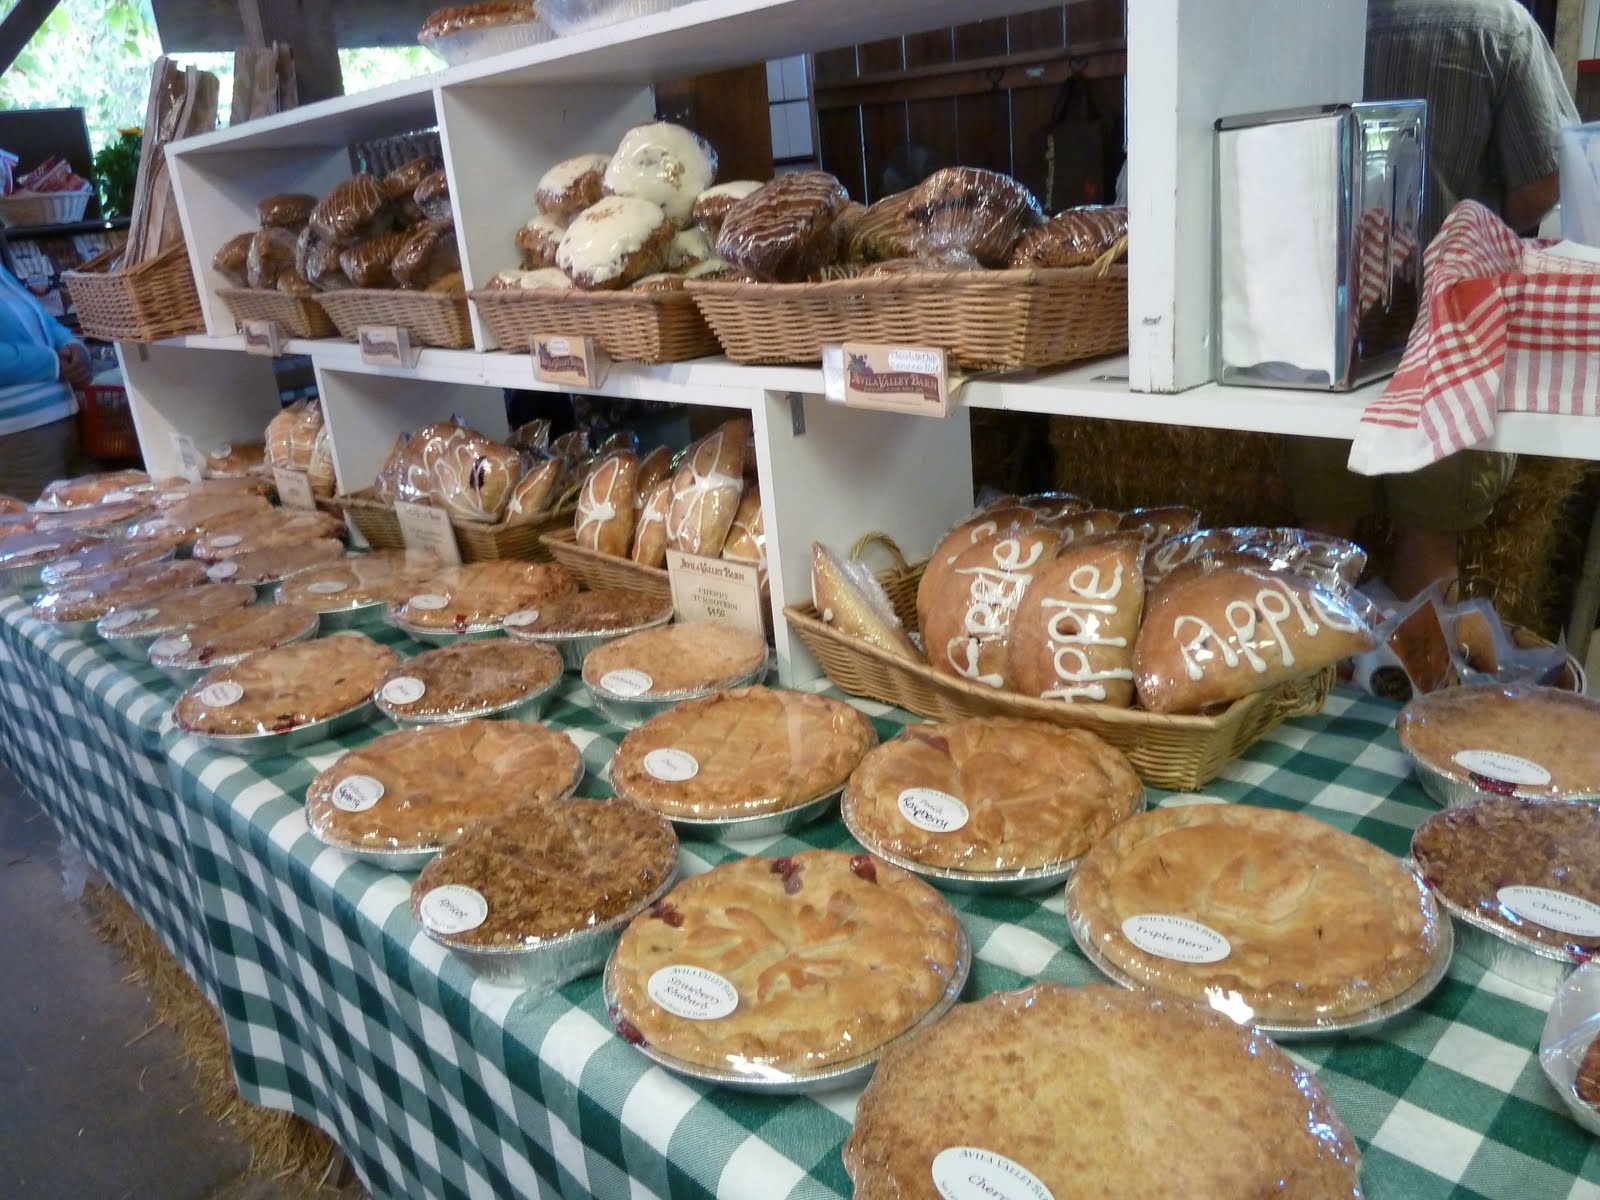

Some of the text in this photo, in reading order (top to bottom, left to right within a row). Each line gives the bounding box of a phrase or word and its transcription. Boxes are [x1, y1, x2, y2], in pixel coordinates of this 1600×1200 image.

[851, 373, 878, 387] AVILA
[878, 374, 909, 389] VALLEY
[910, 374, 937, 391] BARN
[700, 562, 723, 577] VALLEY
[724, 567, 745, 581] BARN
[946, 539, 1044, 689] Apple
[903, 796, 949, 830] Raspberry
[1137, 925, 1174, 941] Triple
[1177, 936, 1213, 953] Berry
[961, 1149, 993, 1165] AVILA
[996, 1159, 1032, 1186] VALLEY
[968, 1174, 1012, 1200] Cherr
